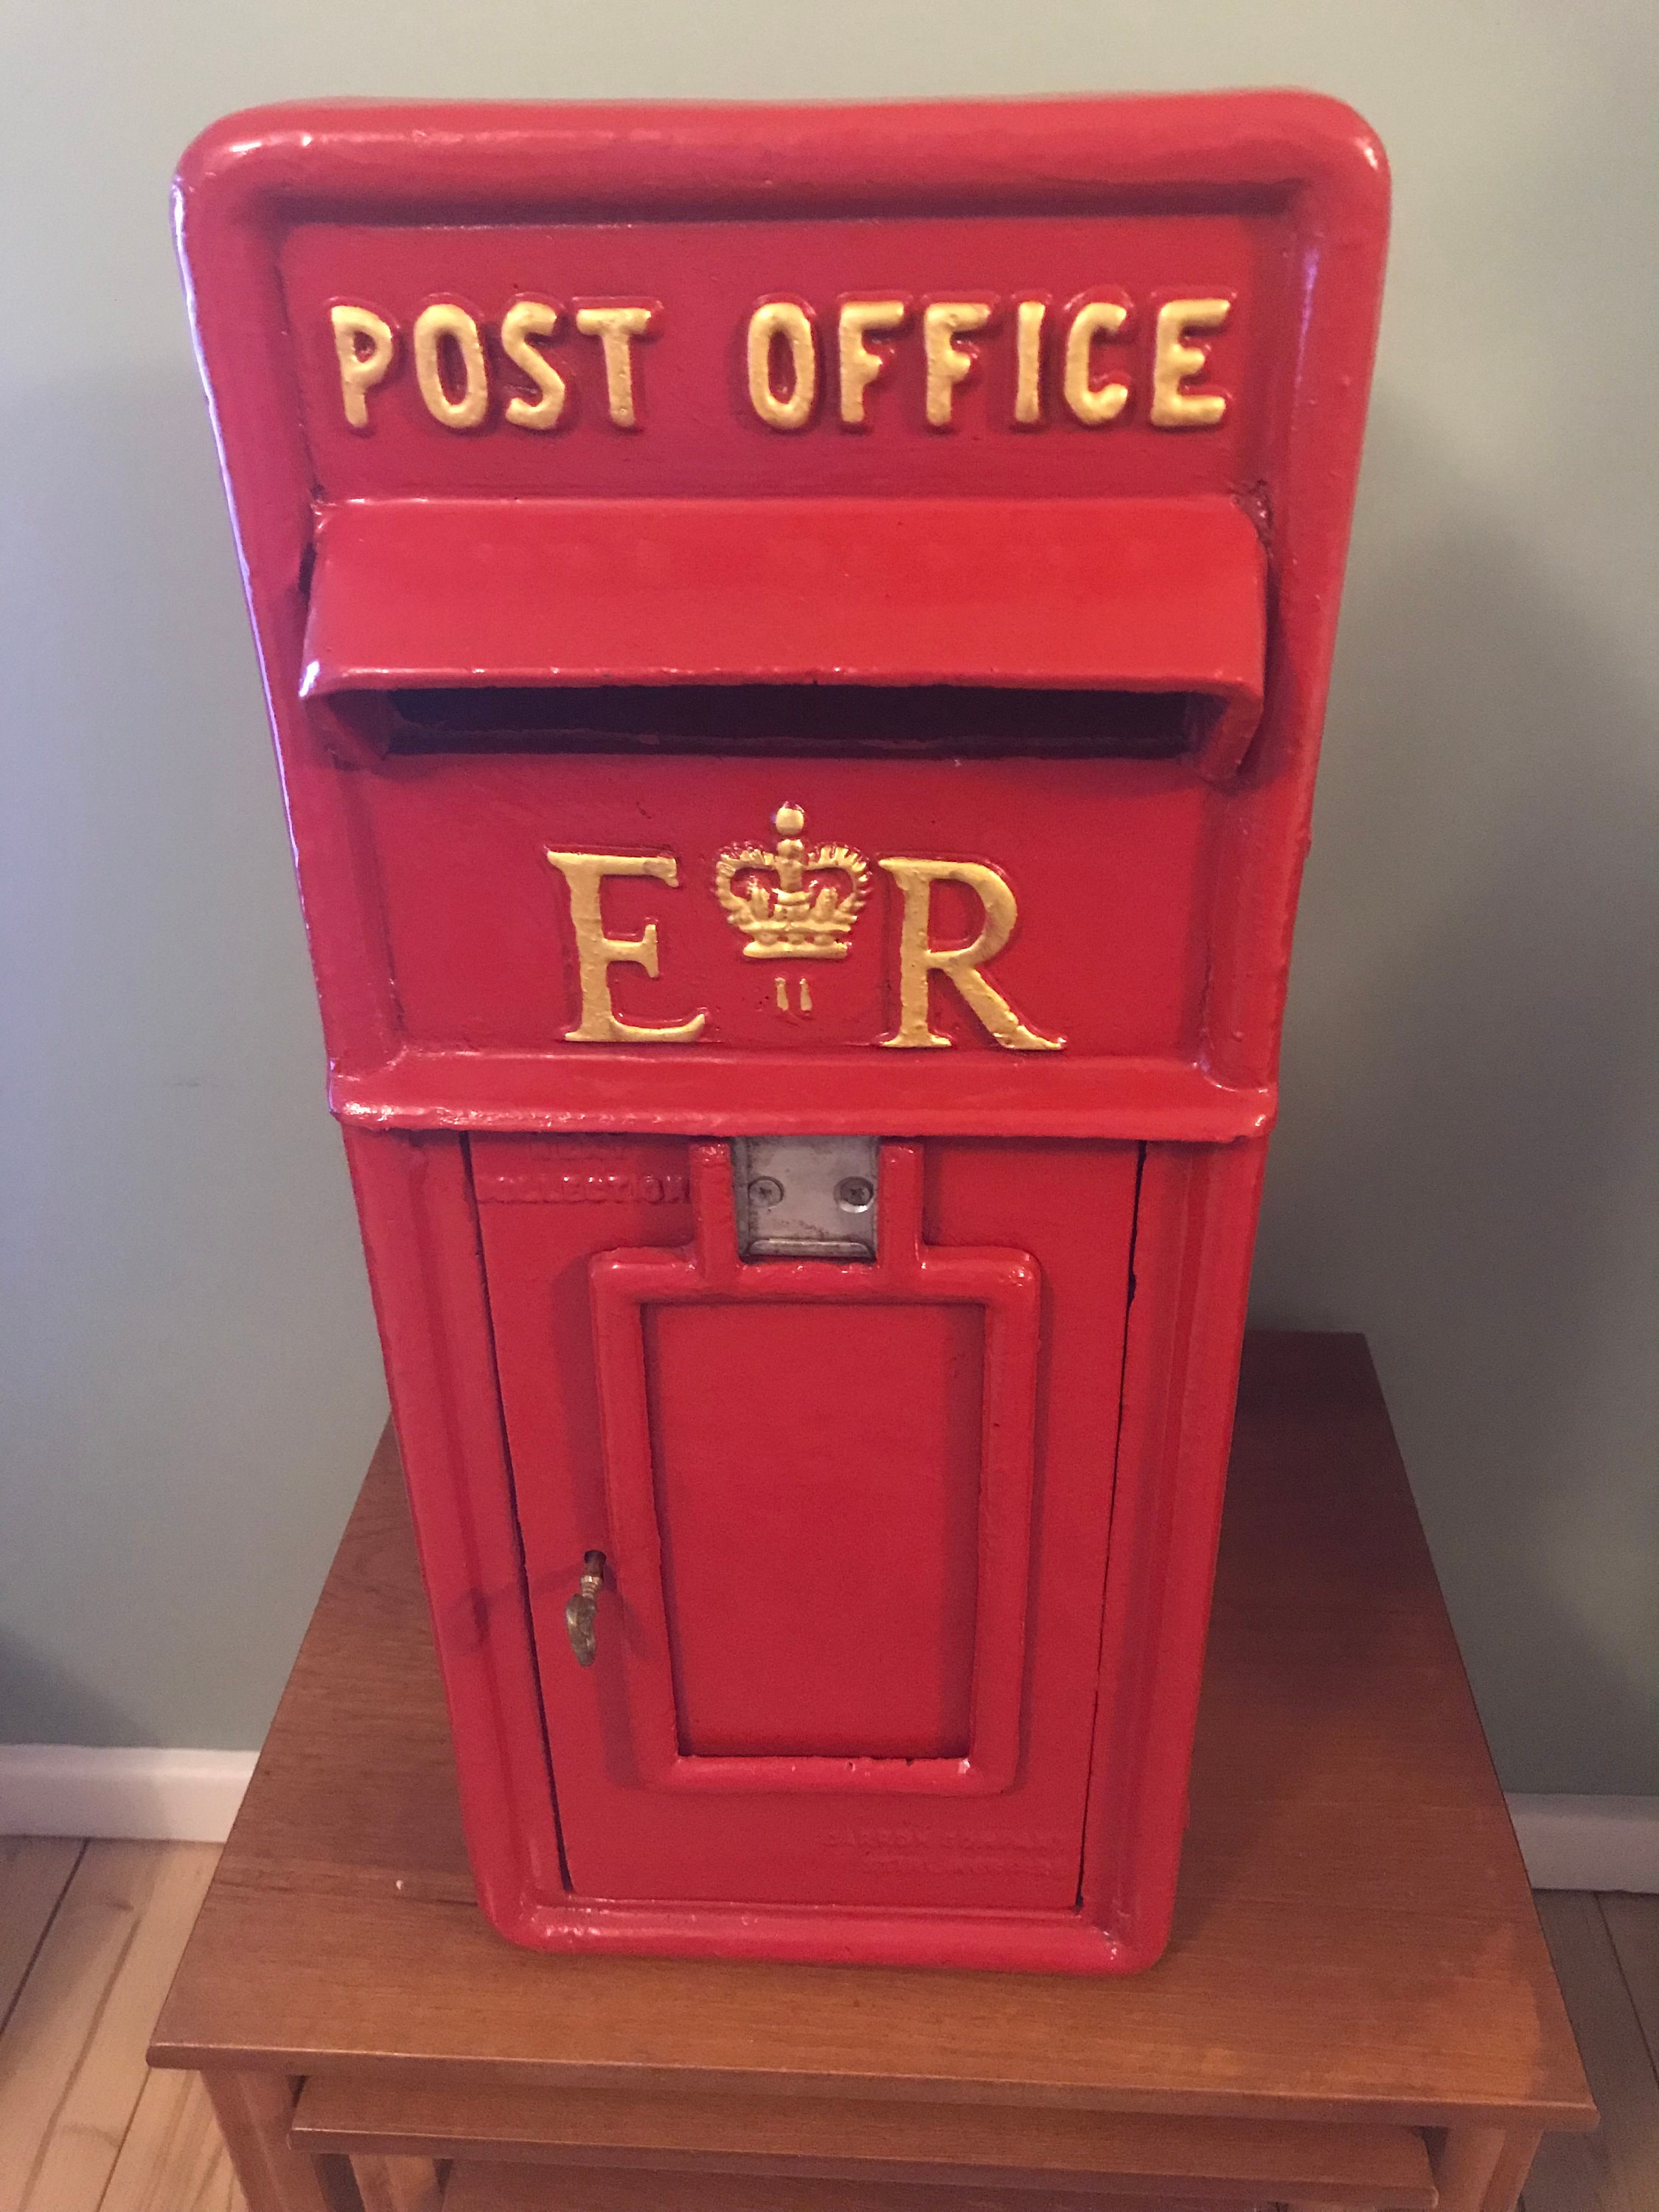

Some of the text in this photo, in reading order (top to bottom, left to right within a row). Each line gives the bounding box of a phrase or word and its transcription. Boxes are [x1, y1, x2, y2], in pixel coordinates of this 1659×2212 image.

[329, 298, 1231, 429] POST OFFICE
[546, 849, 1067, 1050] E R
